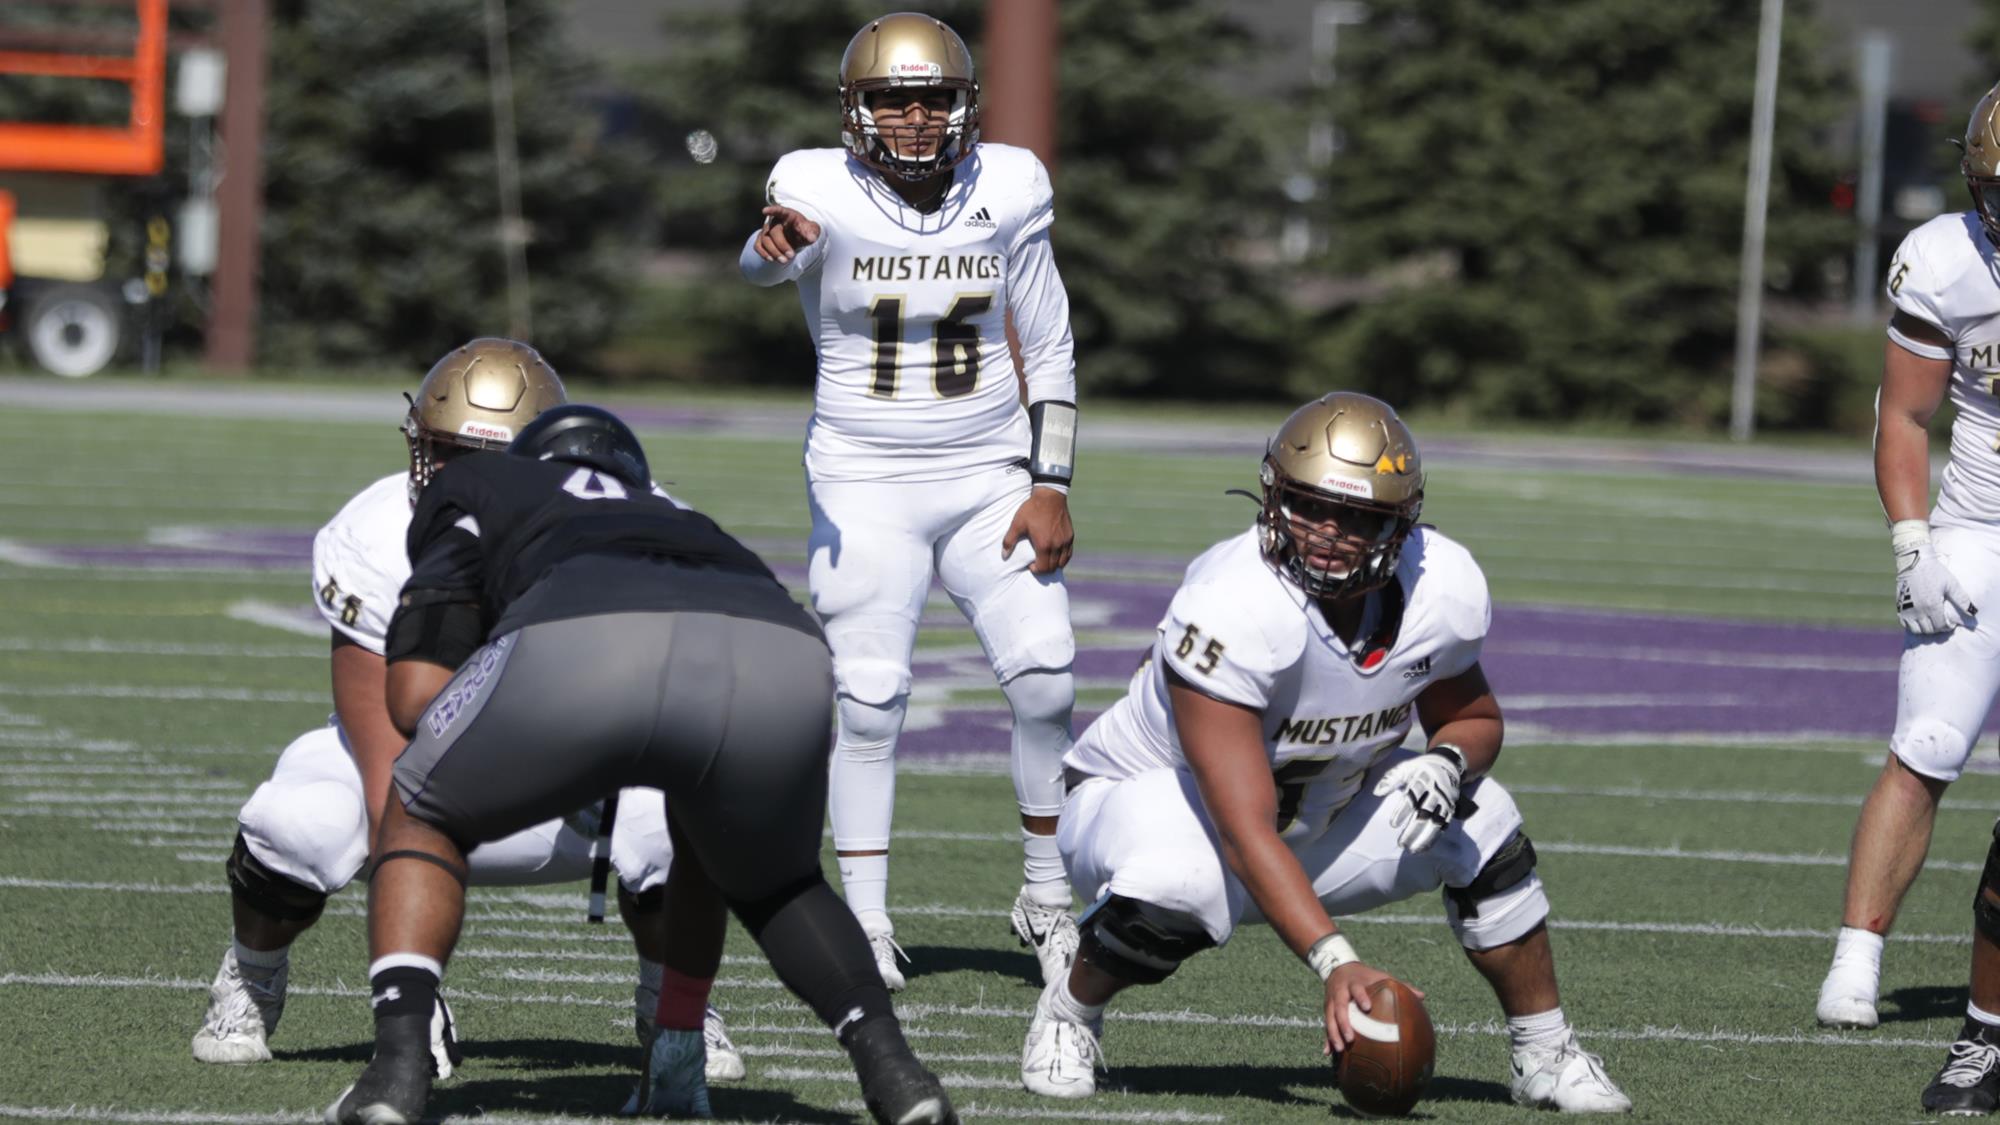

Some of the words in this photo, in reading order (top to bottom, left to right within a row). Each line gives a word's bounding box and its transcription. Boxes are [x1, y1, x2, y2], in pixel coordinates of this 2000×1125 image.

[900, 64, 929, 72] Riddell
[964, 219, 997, 229] adidas
[852, 255, 1000, 281] MUSTANGS
[866, 290, 995, 400] 16
[466, 425, 508, 439] Riddell
[1175, 623, 1225, 676] 65
